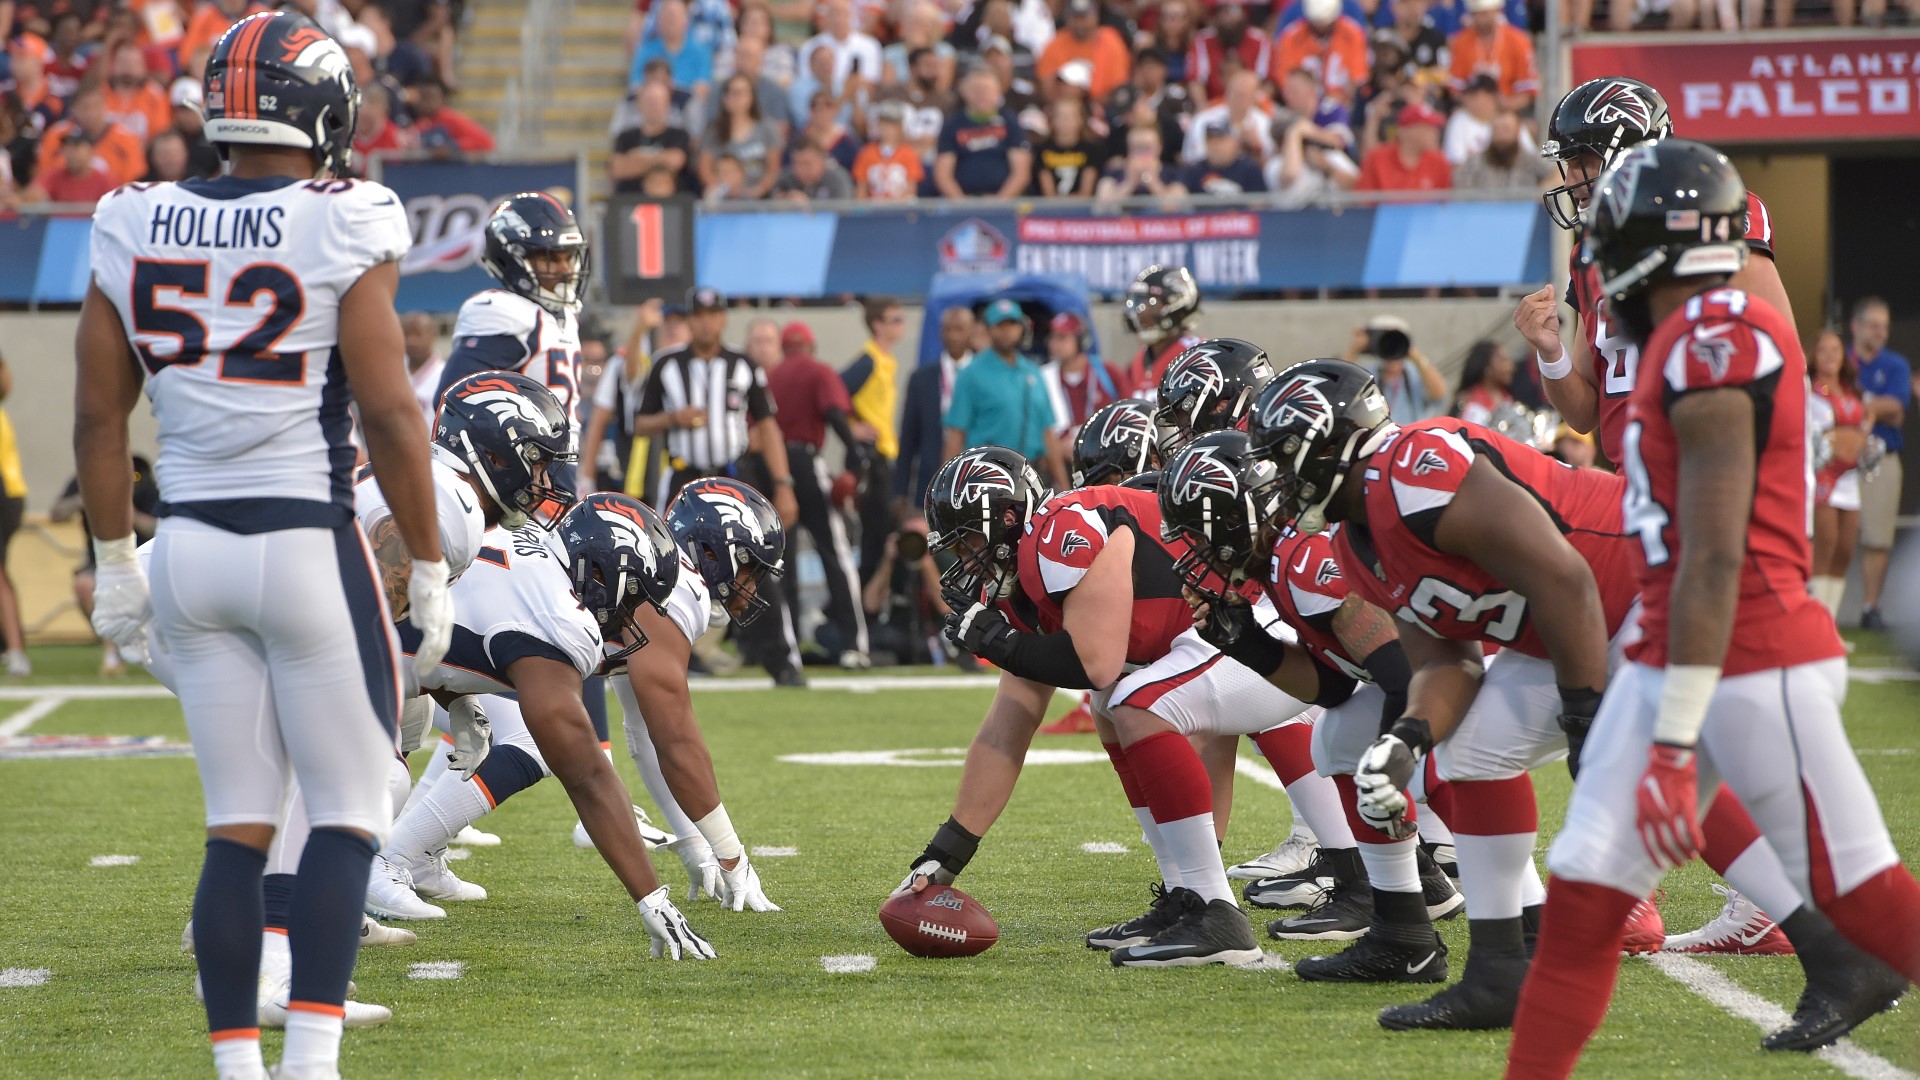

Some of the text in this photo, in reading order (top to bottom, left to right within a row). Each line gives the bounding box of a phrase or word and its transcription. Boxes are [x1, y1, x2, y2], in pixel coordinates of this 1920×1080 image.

[259, 95, 278, 111] 52
[1681, 78, 1920, 119] FALCO
[217, 124, 270, 135] BRONCOS
[151, 204, 285, 248] HOLLINS
[629, 203, 665, 279] 1
[1700, 215, 1730, 243] 14
[131, 256, 308, 387] 52
